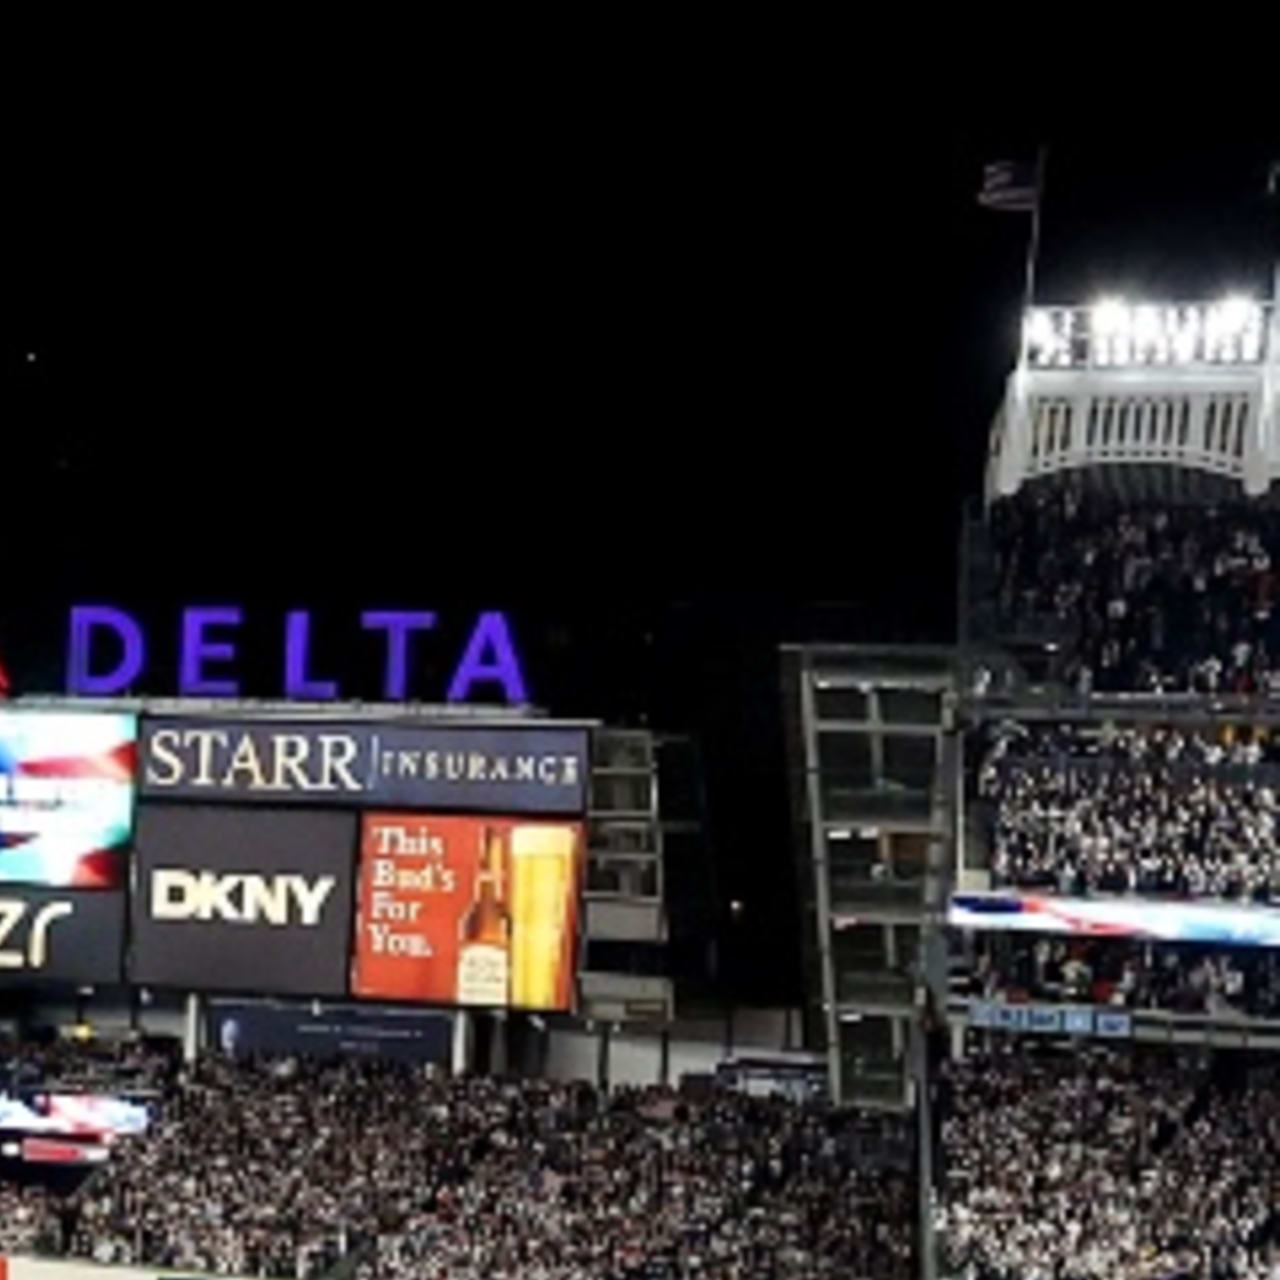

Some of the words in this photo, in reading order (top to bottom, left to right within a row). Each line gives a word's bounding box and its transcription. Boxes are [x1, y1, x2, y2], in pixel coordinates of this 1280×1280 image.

[66, 605, 528, 706] DELTA
[146, 729, 364, 791] STARR
[381, 751, 580, 785] INSURANCE
[371, 825, 444, 856] This
[151, 868, 336, 925] DKNY
[371, 857, 456, 892] Bud's
[370, 890, 423, 920] For
